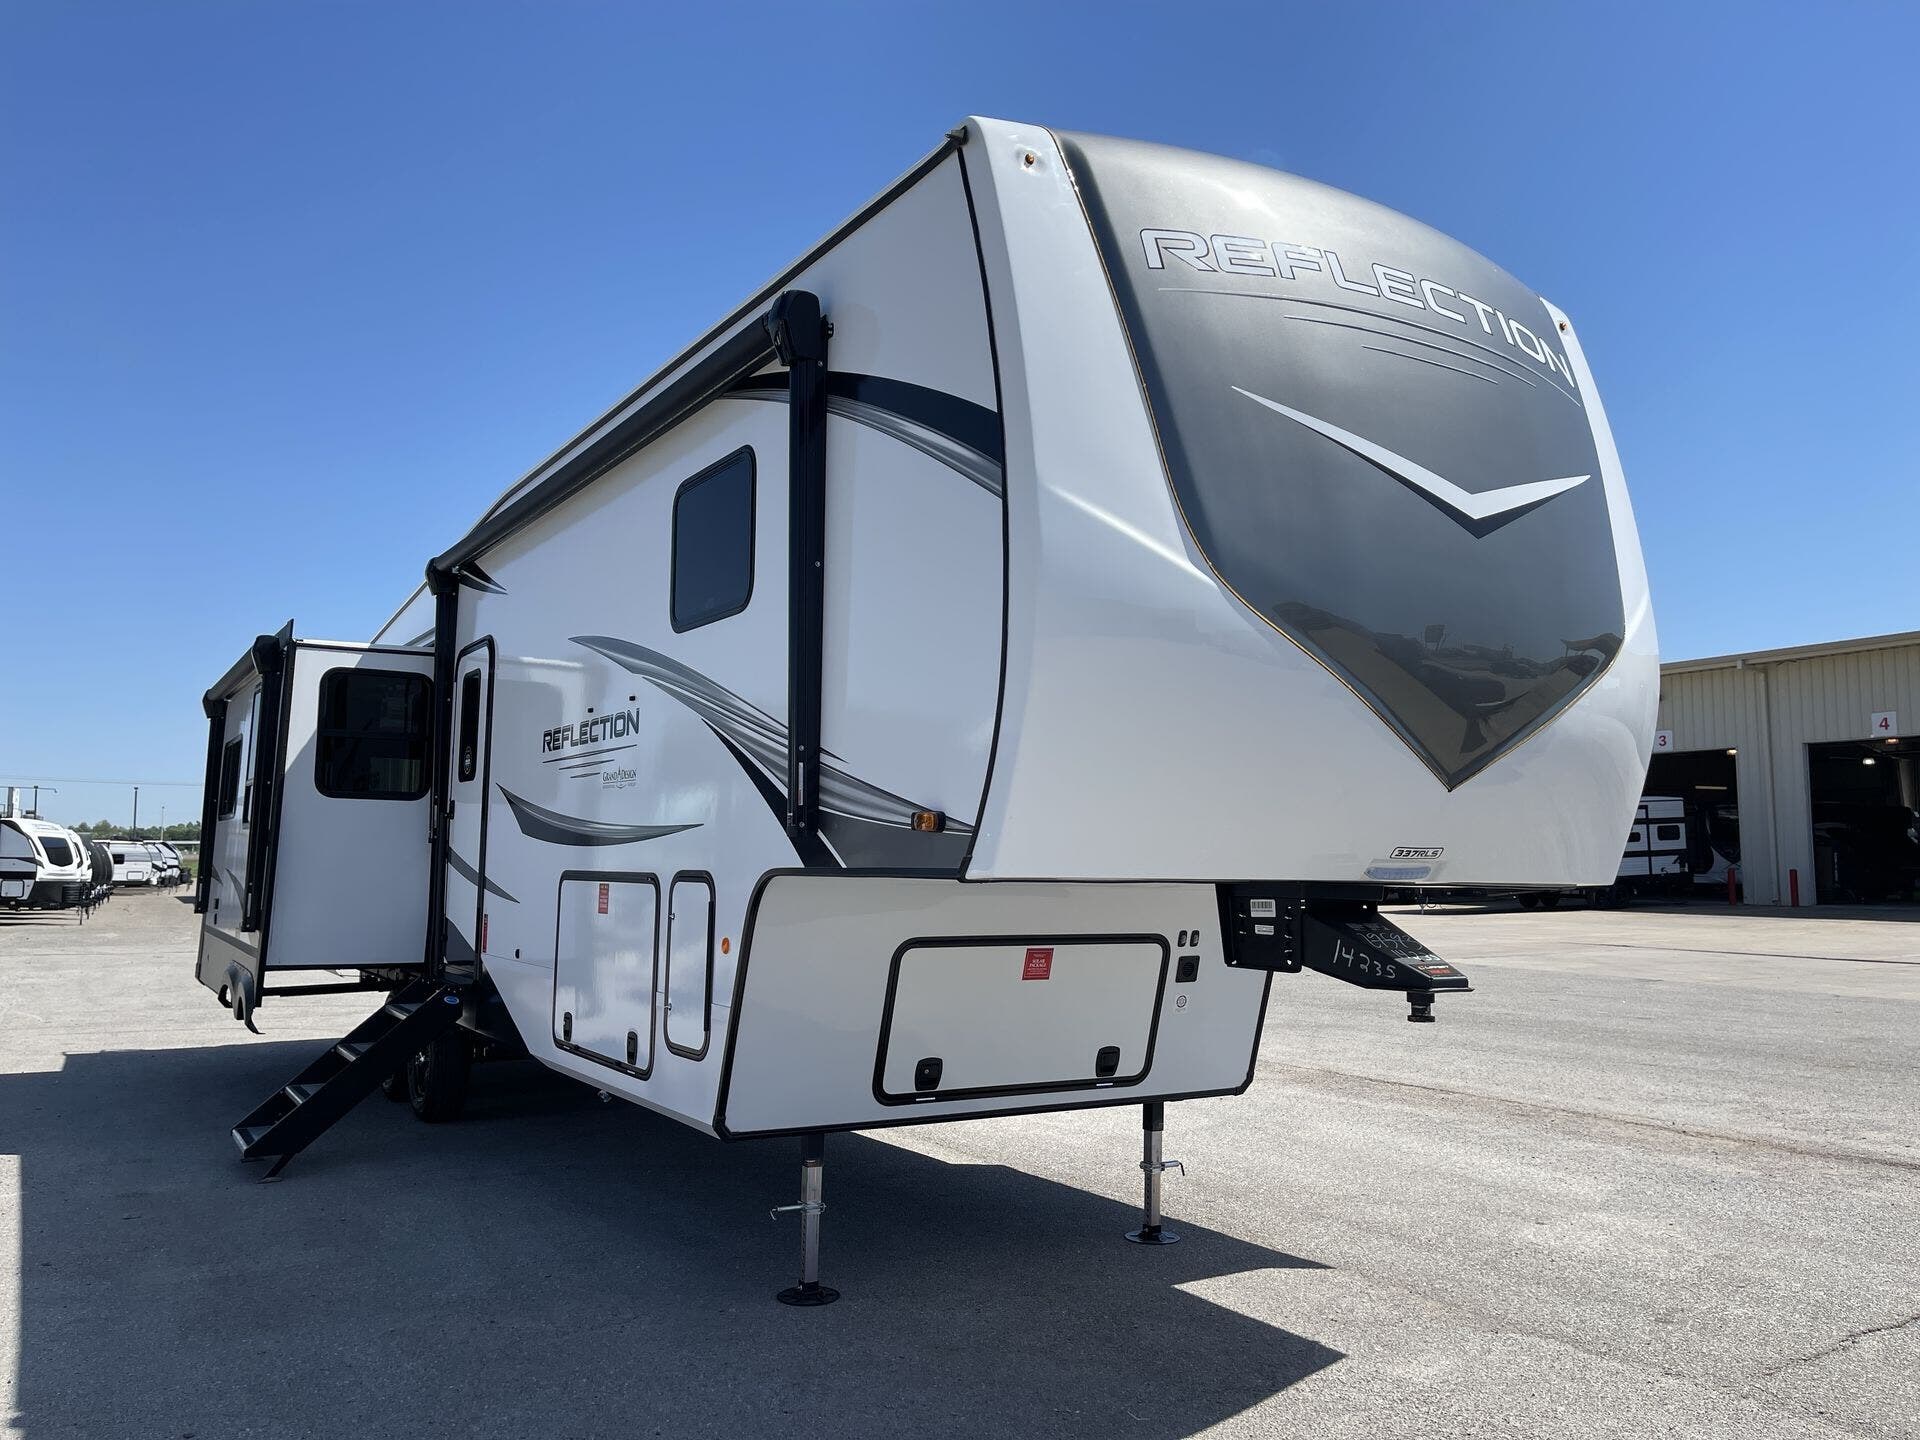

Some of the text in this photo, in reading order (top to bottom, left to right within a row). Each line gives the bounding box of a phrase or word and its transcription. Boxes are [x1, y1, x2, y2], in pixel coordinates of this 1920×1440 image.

[1140, 228, 1575, 388] REFLECTION
[543, 707, 640, 753] REFLECTION
[1879, 716, 1890, 731] 4
[1658, 735, 1667, 747] 3
[1394, 849, 1439, 858] 337RLS
[1333, 939, 1397, 979] 14235
